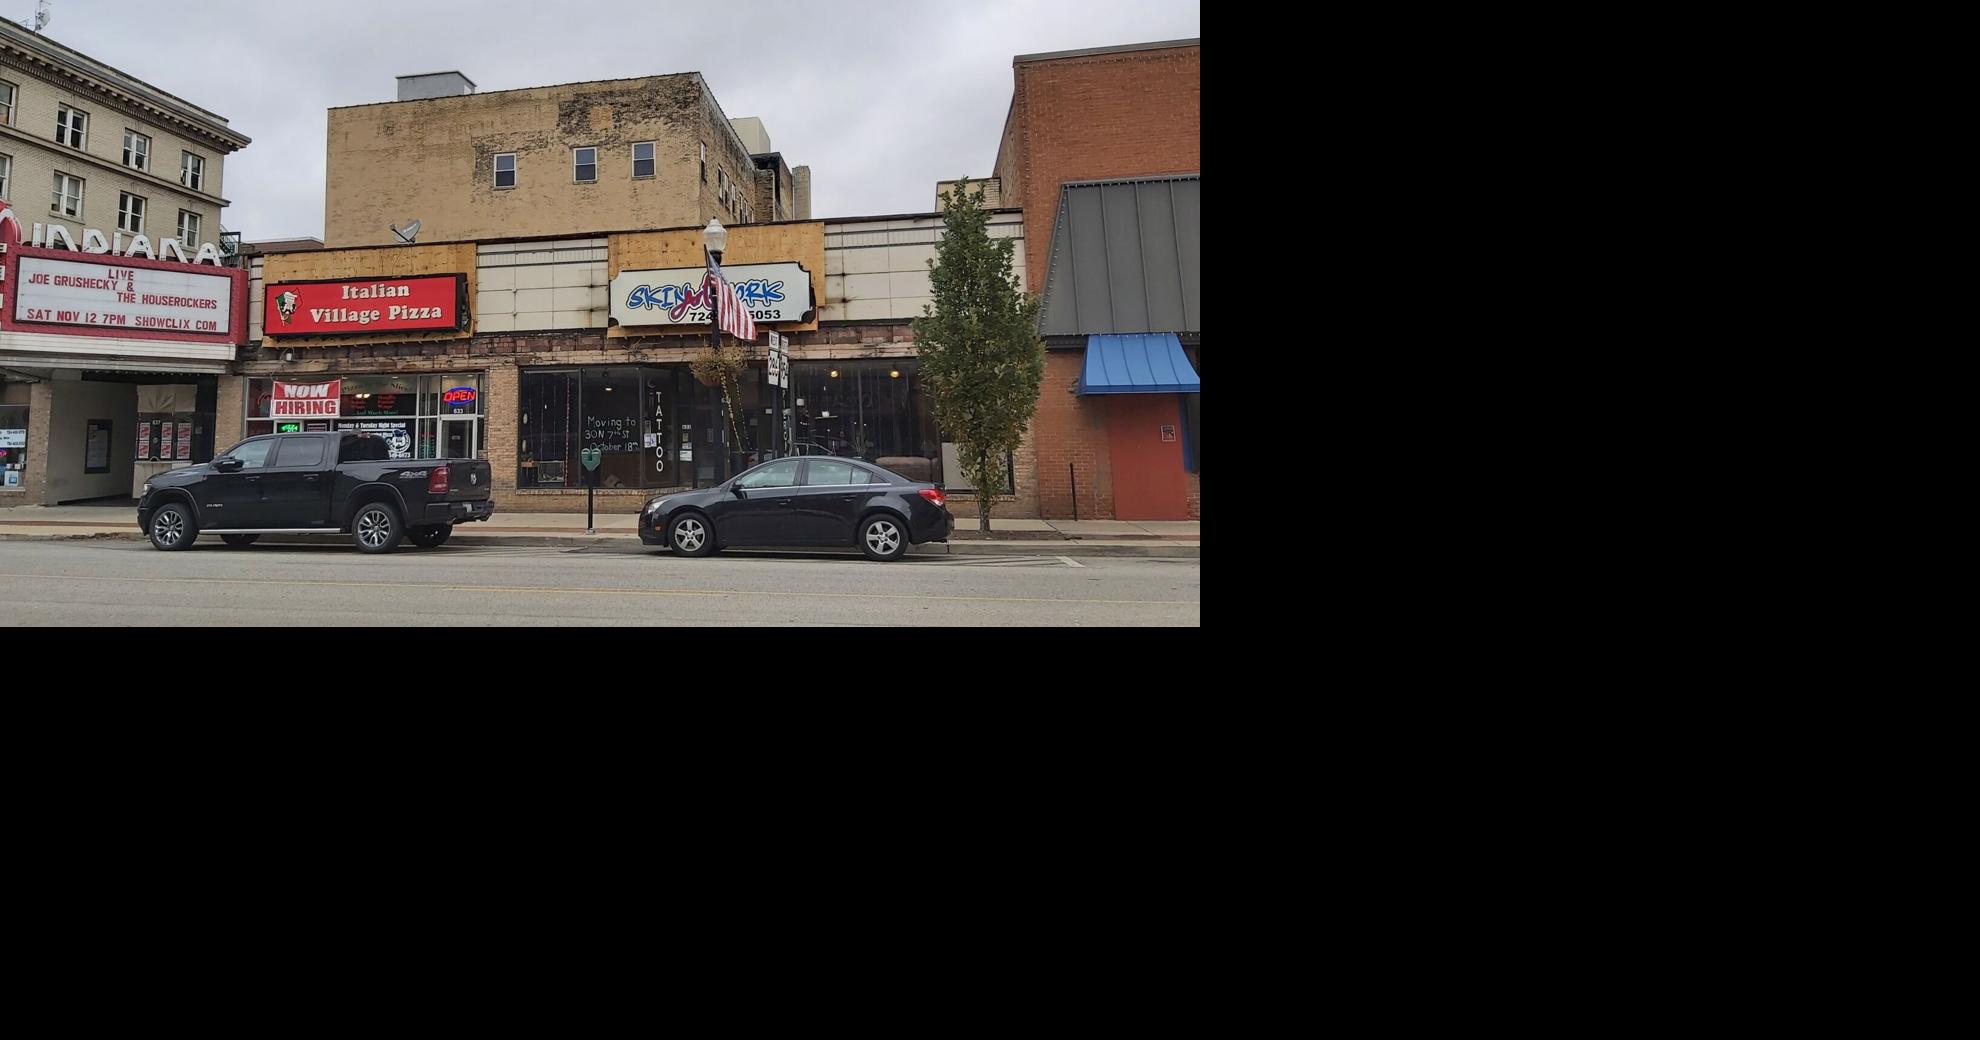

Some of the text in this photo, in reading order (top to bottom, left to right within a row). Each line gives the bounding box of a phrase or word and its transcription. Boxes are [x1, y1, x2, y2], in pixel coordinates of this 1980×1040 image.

[31, 222, 222, 267] INDIANA
[28, 273, 135, 292] JOE GRUSHECKY &
[108, 269, 134, 281] LIVE
[117, 291, 217, 309] THE HOUSEROCKERS
[341, 283, 410, 300] Italian
[626, 282, 690, 311] SKIN
[27, 308, 217, 331] SAT NOV 12 7PM SHOWCLIX COM
[310, 304, 442, 324] Village Pizza
[284, 384, 330, 398] NOW
[443, 390, 476, 402] OPEN
[275, 400, 337, 415] HIRING
[587, 415, 636, 430] Moving to
[655, 391, 664, 473] TATTOO
[590, 441, 622, 452] October
